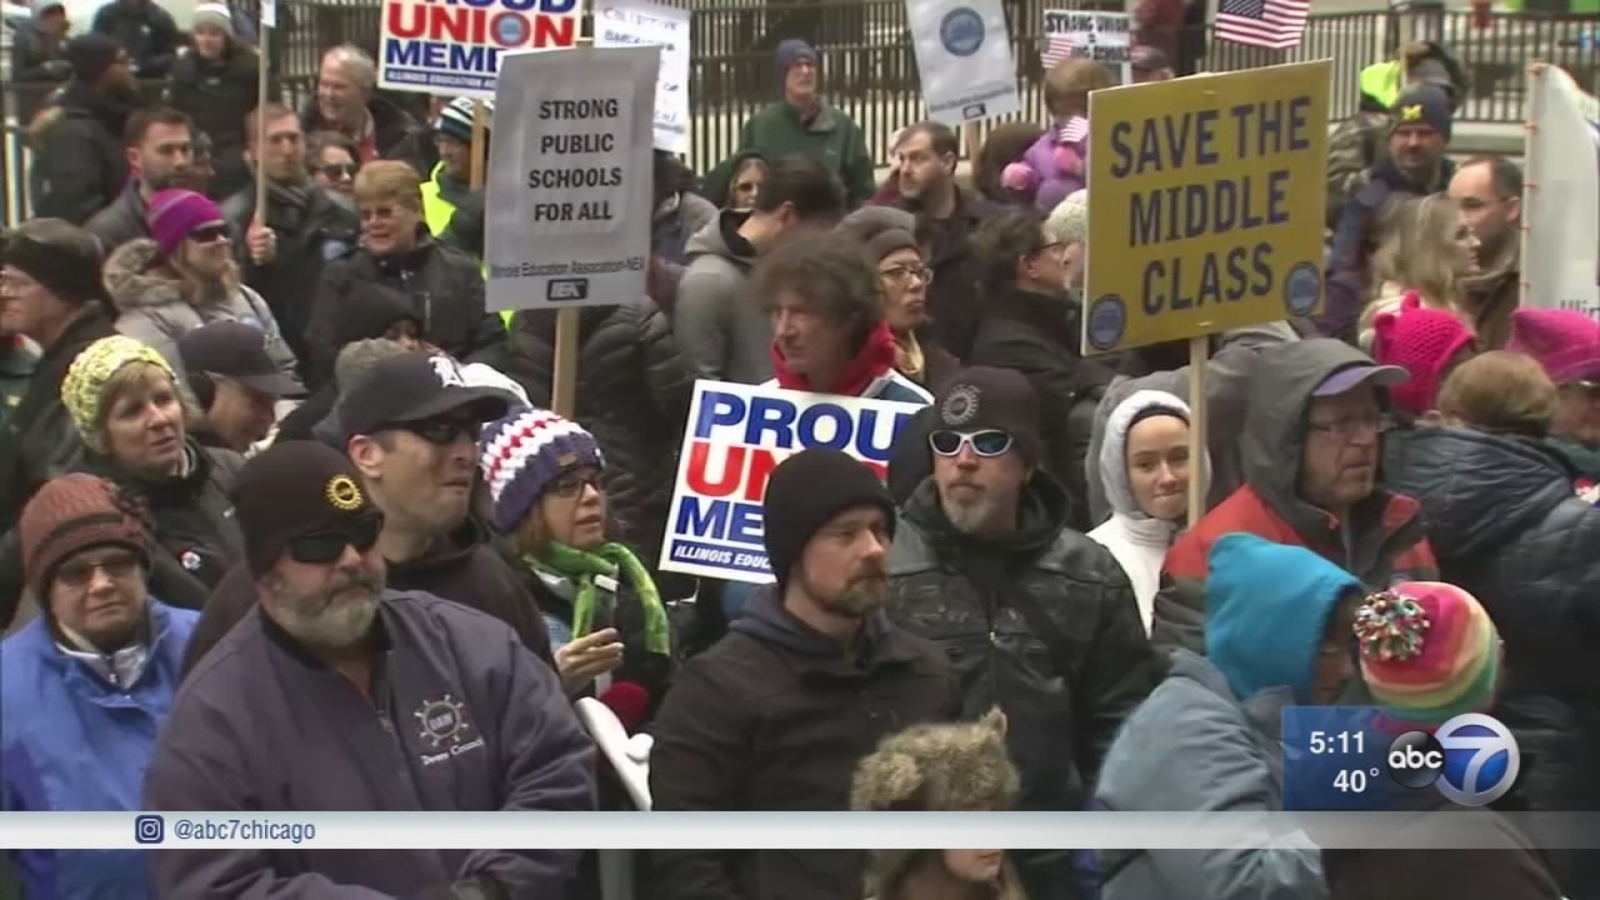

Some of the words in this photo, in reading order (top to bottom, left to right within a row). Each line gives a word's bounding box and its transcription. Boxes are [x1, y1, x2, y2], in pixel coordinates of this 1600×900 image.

[387, 2, 575, 48] UNION
[539, 98, 619, 120] STRONG
[540, 133, 615, 155] PUBLIC
[1109, 109, 1221, 179] SAVE
[1230, 95, 1312, 160] THE
[528, 167, 622, 189] SCHOOLS
[534, 203, 577, 222] FOR
[578, 200, 614, 220] ALL
[1128, 170, 1291, 248] MIDDLE
[521, 262, 569, 277] Education
[1141, 242, 1275, 316] CLASS
[674, 545, 734, 565] ILLINOIS
